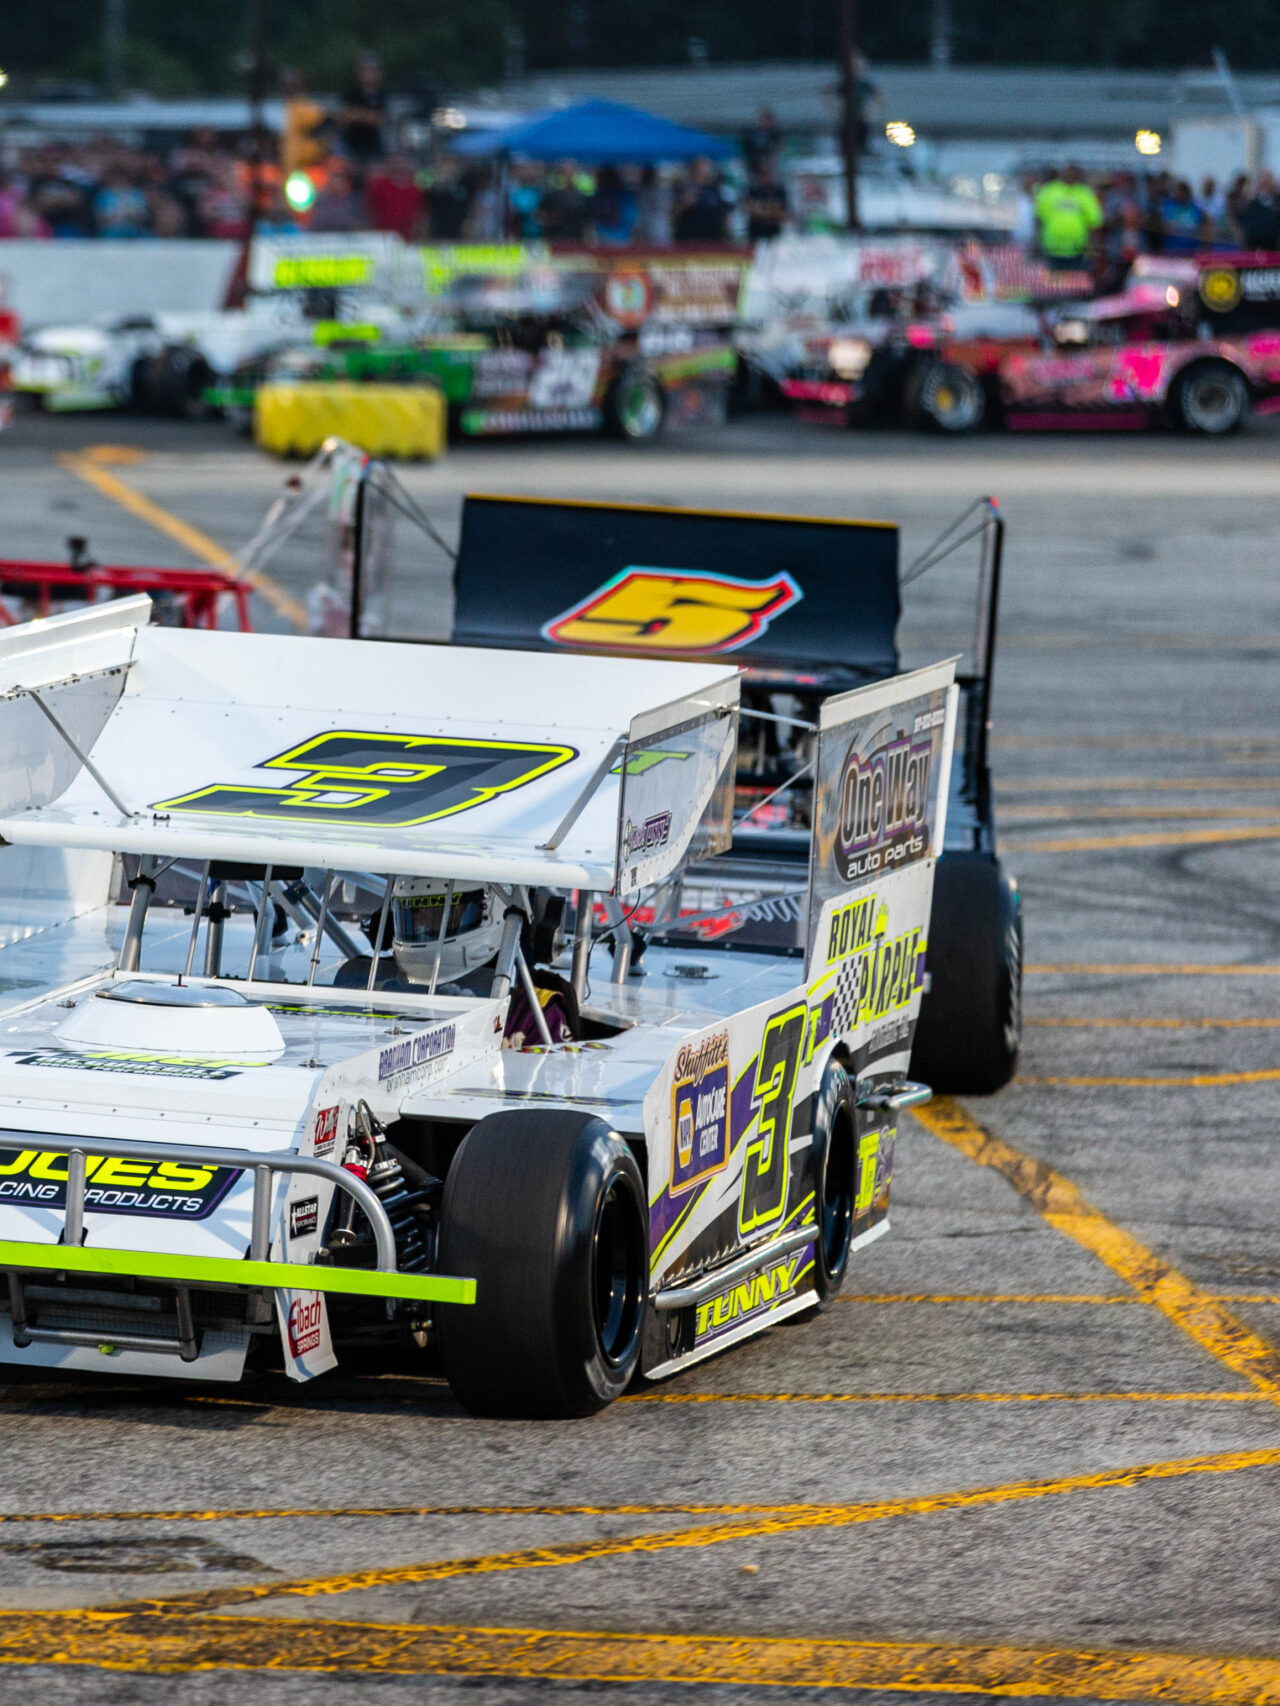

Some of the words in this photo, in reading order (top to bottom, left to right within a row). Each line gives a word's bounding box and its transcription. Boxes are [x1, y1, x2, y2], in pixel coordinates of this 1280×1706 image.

[541, 565, 804, 656] 5
[148, 730, 580, 827] 3
[842, 760, 883, 847] One
[885, 742, 931, 831] Way
[847, 851, 880, 879] auto
[884, 834, 923, 864] parts
[826, 893, 877, 966] ROYAL
[852, 926, 928, 1031] PURPLE
[737, 1002, 810, 1240] 3
[296, 1203, 318, 1219] ALLSTAR
[695, 1257, 798, 1336] TUNNY
[297, 1332, 320, 1354] SPRINGS
